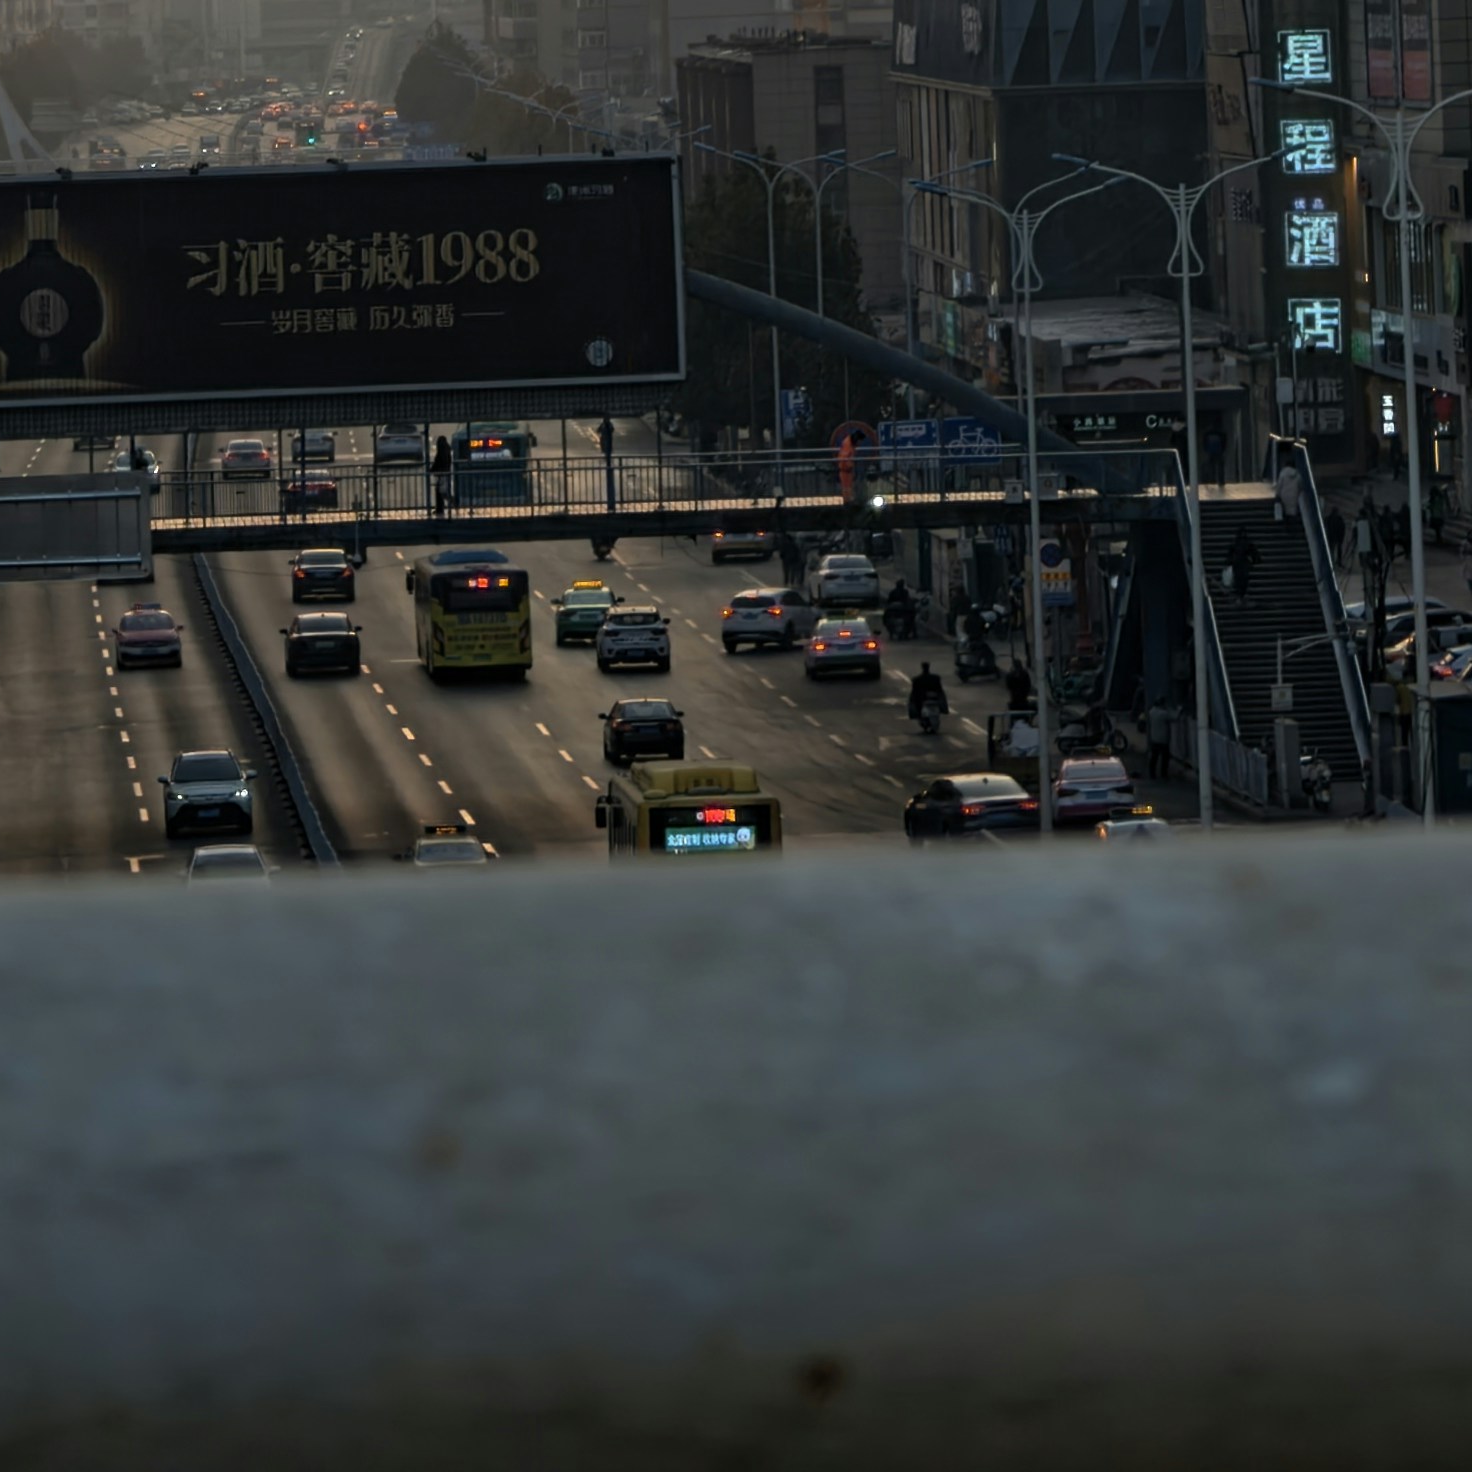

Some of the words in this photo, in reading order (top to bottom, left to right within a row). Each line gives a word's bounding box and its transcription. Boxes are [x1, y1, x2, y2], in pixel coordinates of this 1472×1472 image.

[1278, 29, 1342, 352] 星程酒店
[181, 228, 541, 297] 习酒·窖藏1988
[271, 306, 357, 335] 岁月窖藏
